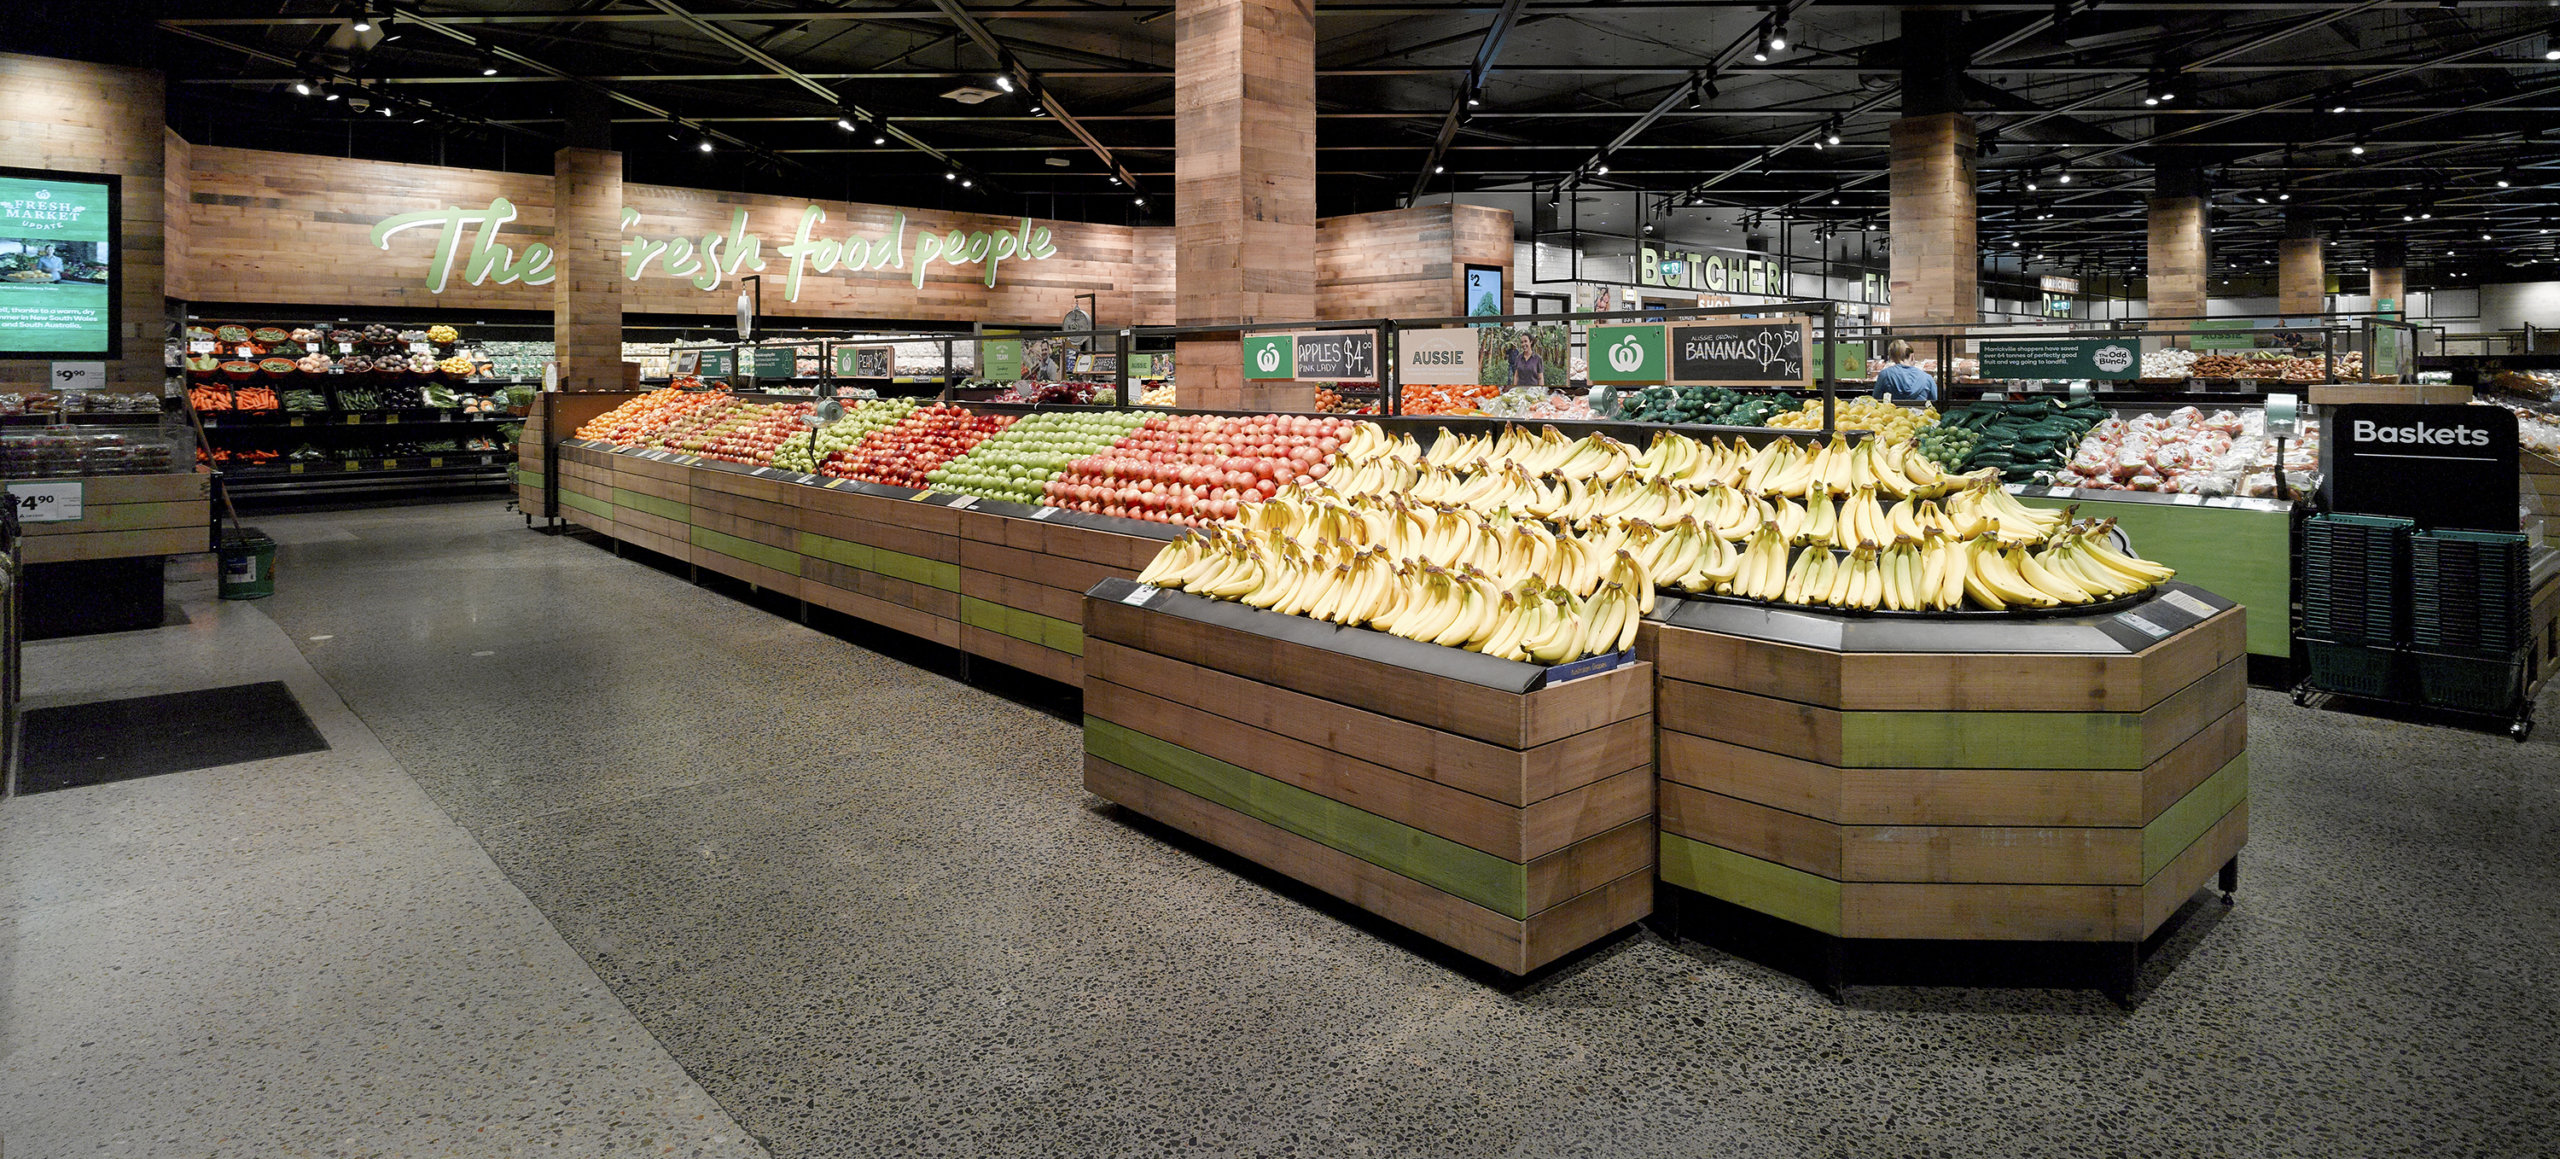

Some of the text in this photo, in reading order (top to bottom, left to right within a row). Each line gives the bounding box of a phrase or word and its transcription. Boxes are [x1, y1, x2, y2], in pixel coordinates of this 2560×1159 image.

[15, 199, 71, 212] FRESH
[6, 208, 80, 221] MARKET
[22, 220, 64, 229] UPDATE
[370, 197, 555, 294] The
[777, 204, 905, 303] food
[912, 217, 1057, 289] people
[1641, 247, 1781, 295] BUTCHER
[1470, 273, 1480, 287] $2
[1865, 273, 1890, 304] FI
[82, 308, 95, 316] dry
[1298, 342, 1341, 363] APPLES
[1412, 350, 1464, 365] AUSSIE
[1685, 338, 1757, 361] BANANAS
[1785, 361, 1800, 379] KG
[1299, 363, 1315, 373] PINK
[1316, 363, 1337, 372] LADY
[2353, 420, 2490, 446] Baskets
